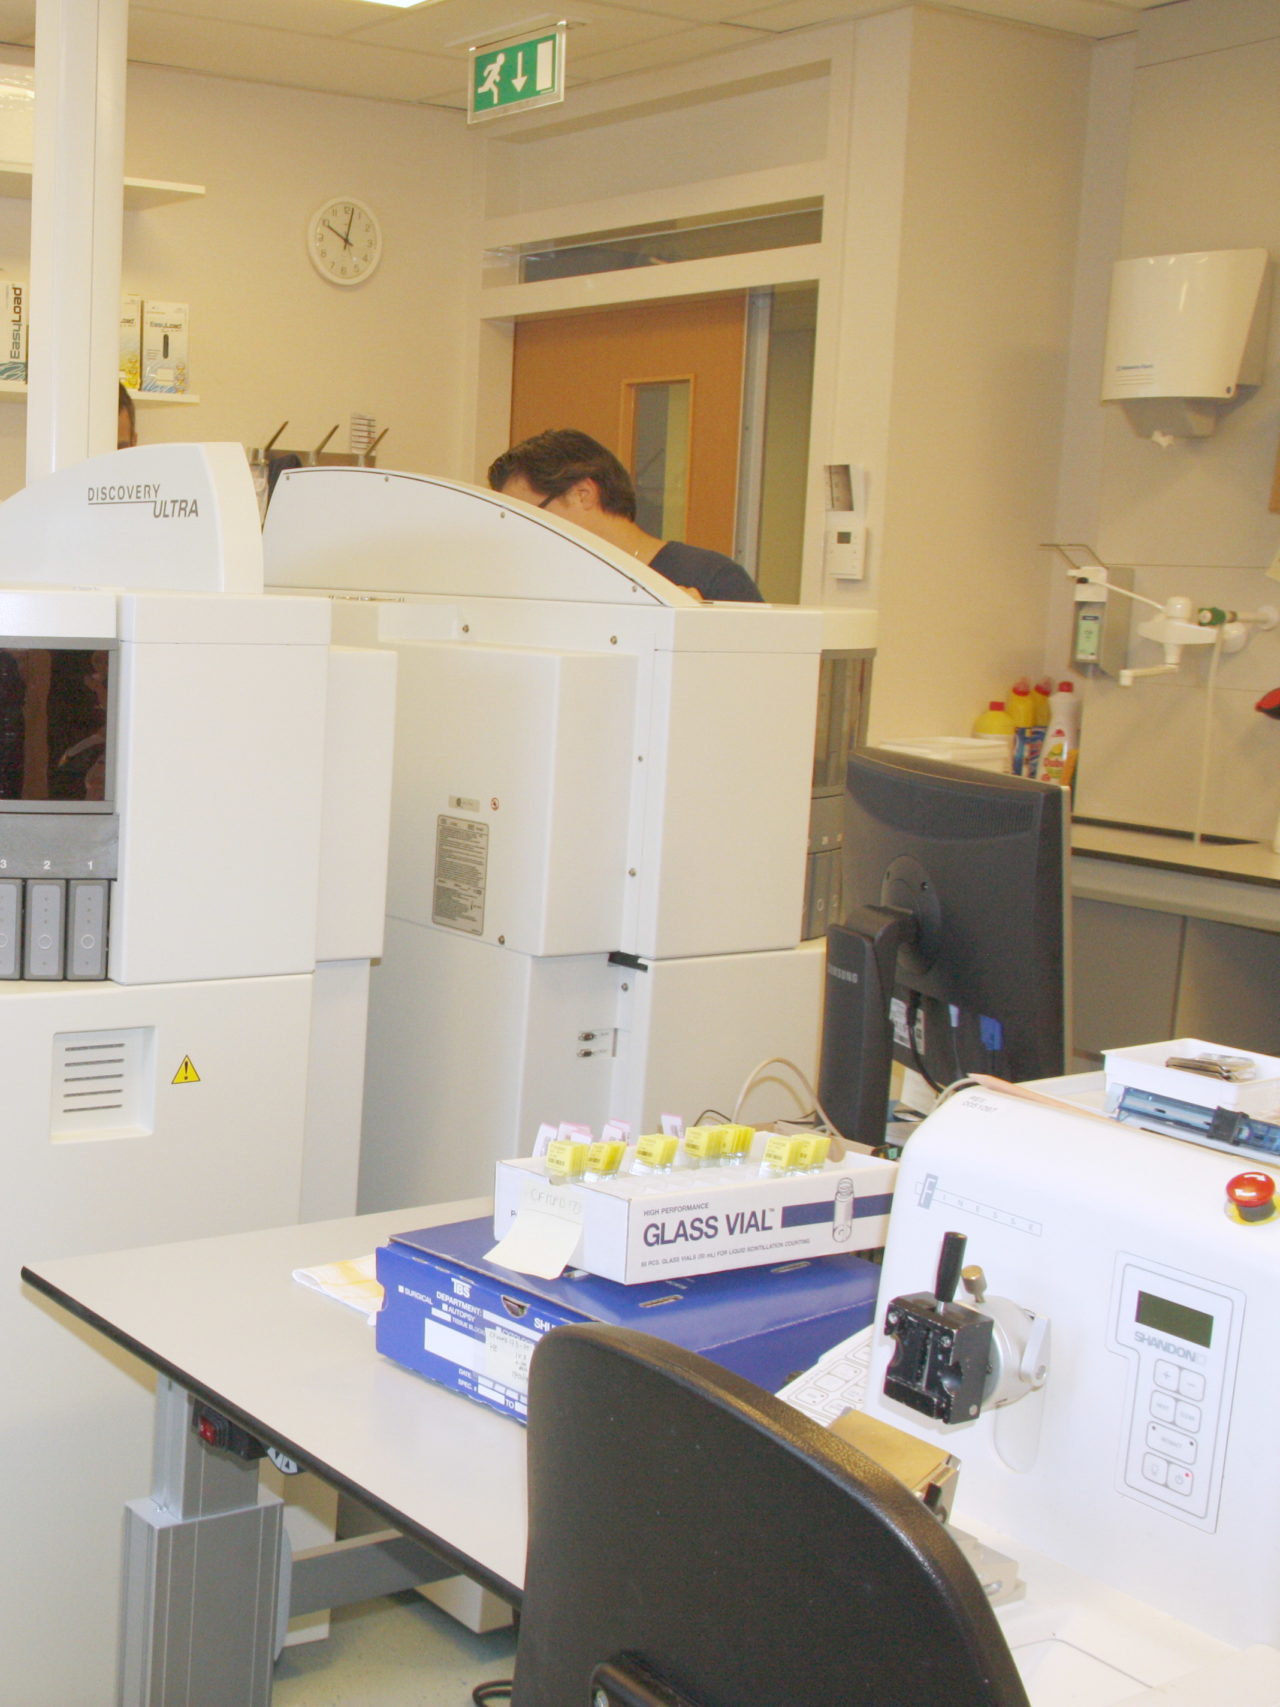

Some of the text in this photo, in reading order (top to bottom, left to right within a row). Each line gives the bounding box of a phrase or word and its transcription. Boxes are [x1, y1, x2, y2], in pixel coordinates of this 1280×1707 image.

[87, 484, 161, 502] DISCOVERY
[153, 499, 199, 519] ULTRA
[0, 858, 8, 869] 3
[43, 859, 52, 870] 2
[87, 860, 94, 871] 1
[643, 1202, 710, 1217] HIGH PERFORMANCE
[643, 1215, 719, 1248] GLASS
[717, 1249, 728, 1257] FOR
[728, 1247, 746, 1255] LIQUID
[404, 1287, 434, 1305] SURGICAL
[451, 1278, 472, 1298] TBS
[448, 1305, 476, 1323] AUTOPSY
[1134, 1331, 1196, 1362] SHANDON
